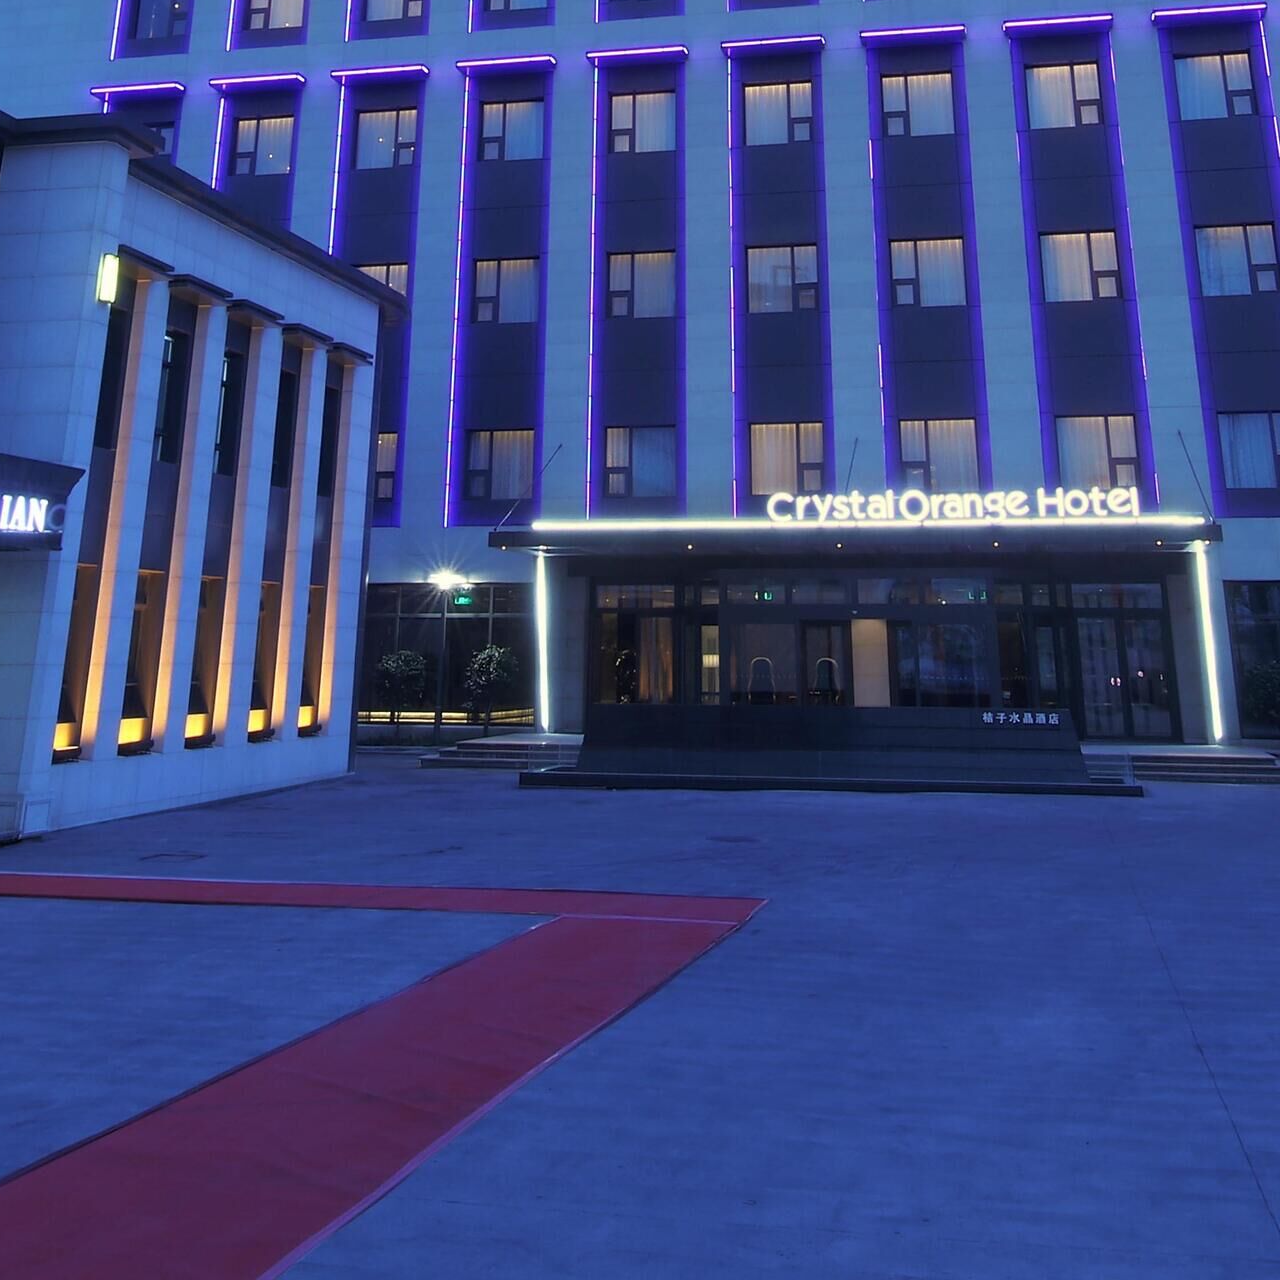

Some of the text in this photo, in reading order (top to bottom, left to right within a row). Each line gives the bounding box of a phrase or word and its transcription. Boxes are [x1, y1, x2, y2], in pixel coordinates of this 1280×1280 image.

[766, 486, 1140, 522] Crystal Orange Hotel
[982, 711, 1059, 725] 桔子水晶酒店
